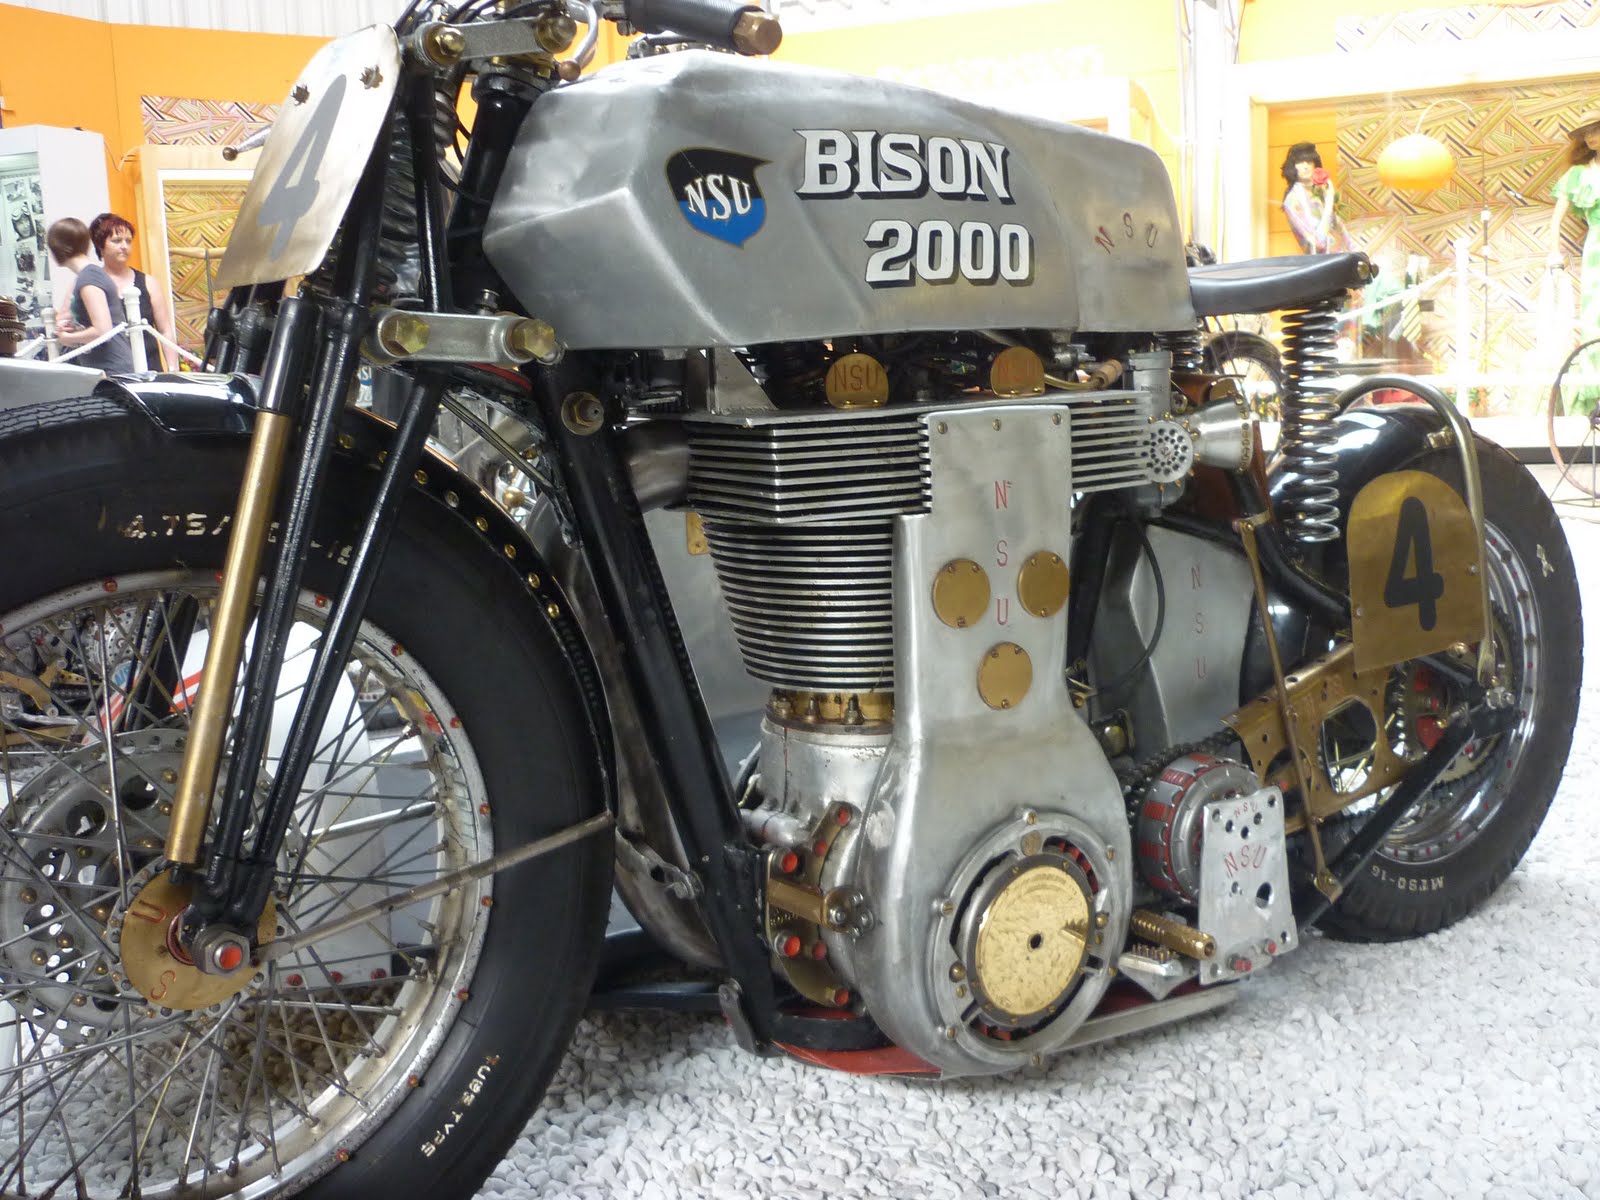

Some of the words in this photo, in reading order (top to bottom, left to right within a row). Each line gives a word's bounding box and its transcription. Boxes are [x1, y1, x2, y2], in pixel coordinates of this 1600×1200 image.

[257, 74, 347, 262] 4
[684, 174, 751, 219] NSU
[794, 129, 1015, 203] BISON
[864, 220, 1033, 289] 2000
[833, 363, 880, 392] NSU
[1384, 496, 1444, 631] 4
[1224, 844, 1267, 878] NSU
